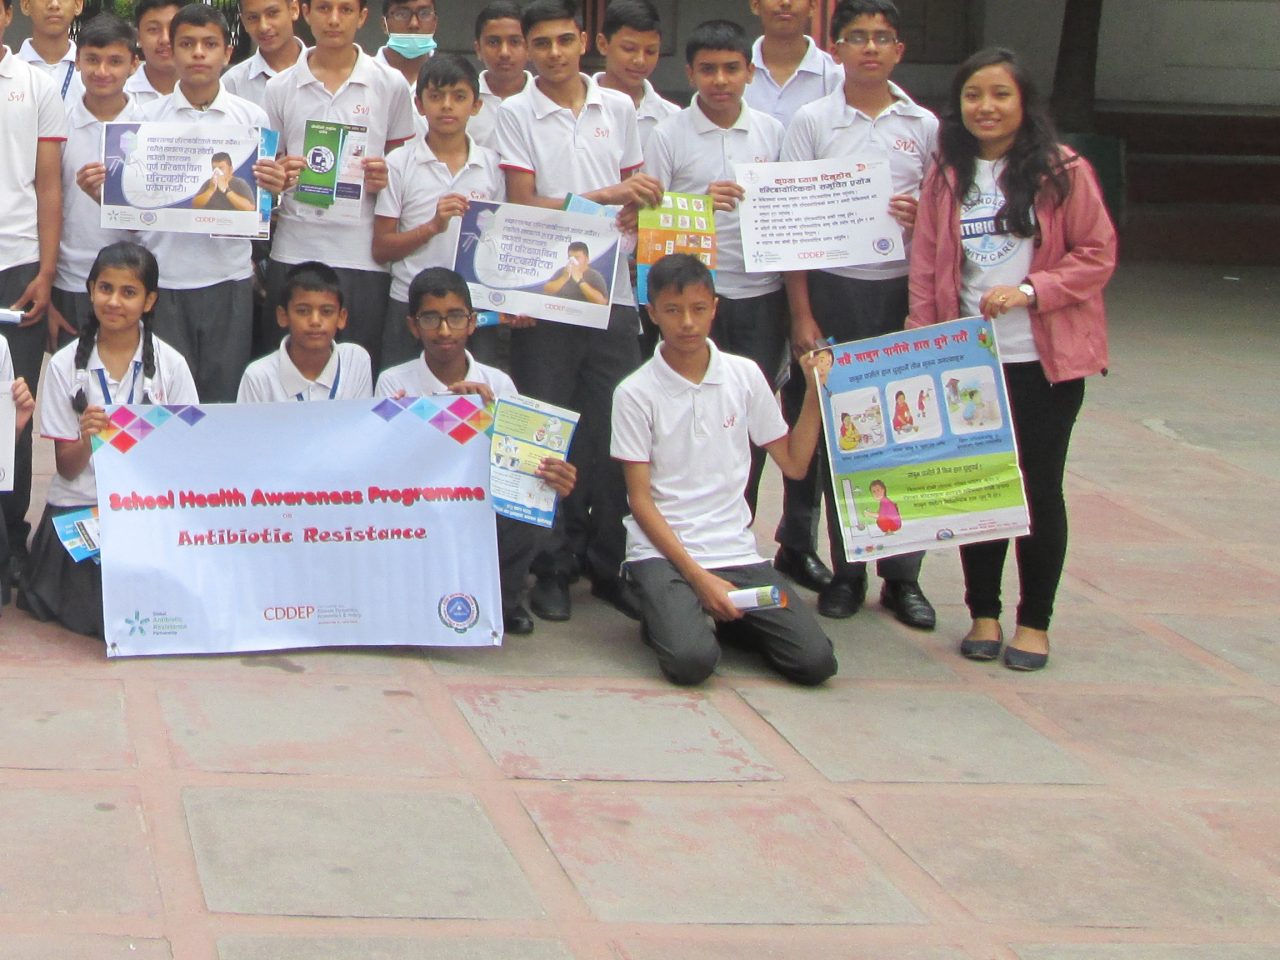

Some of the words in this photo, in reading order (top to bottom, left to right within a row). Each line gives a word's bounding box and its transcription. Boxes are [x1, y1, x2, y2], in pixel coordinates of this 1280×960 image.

[774, 178, 796, 186] कृपया
[798, 176, 818, 184] ध्यान
[850, 178, 871, 187] प्रयोग
[798, 252, 824, 260] CDDEP
[990, 240, 1016, 262] CARE
[855, 350, 880, 364] साबुन
[882, 342, 910, 358] पानीले
[914, 340, 930, 351] हात
[934, 336, 948, 350] धुने
[109, 489, 175, 511] School
[180, 488, 246, 508] Health
[250, 488, 364, 507] Awareness
[368, 486, 485, 507] Programme
[178, 528, 294, 546] Antibiotic
[303, 525, 428, 543] Resistance
[264, 606, 315, 621] CDDEP
